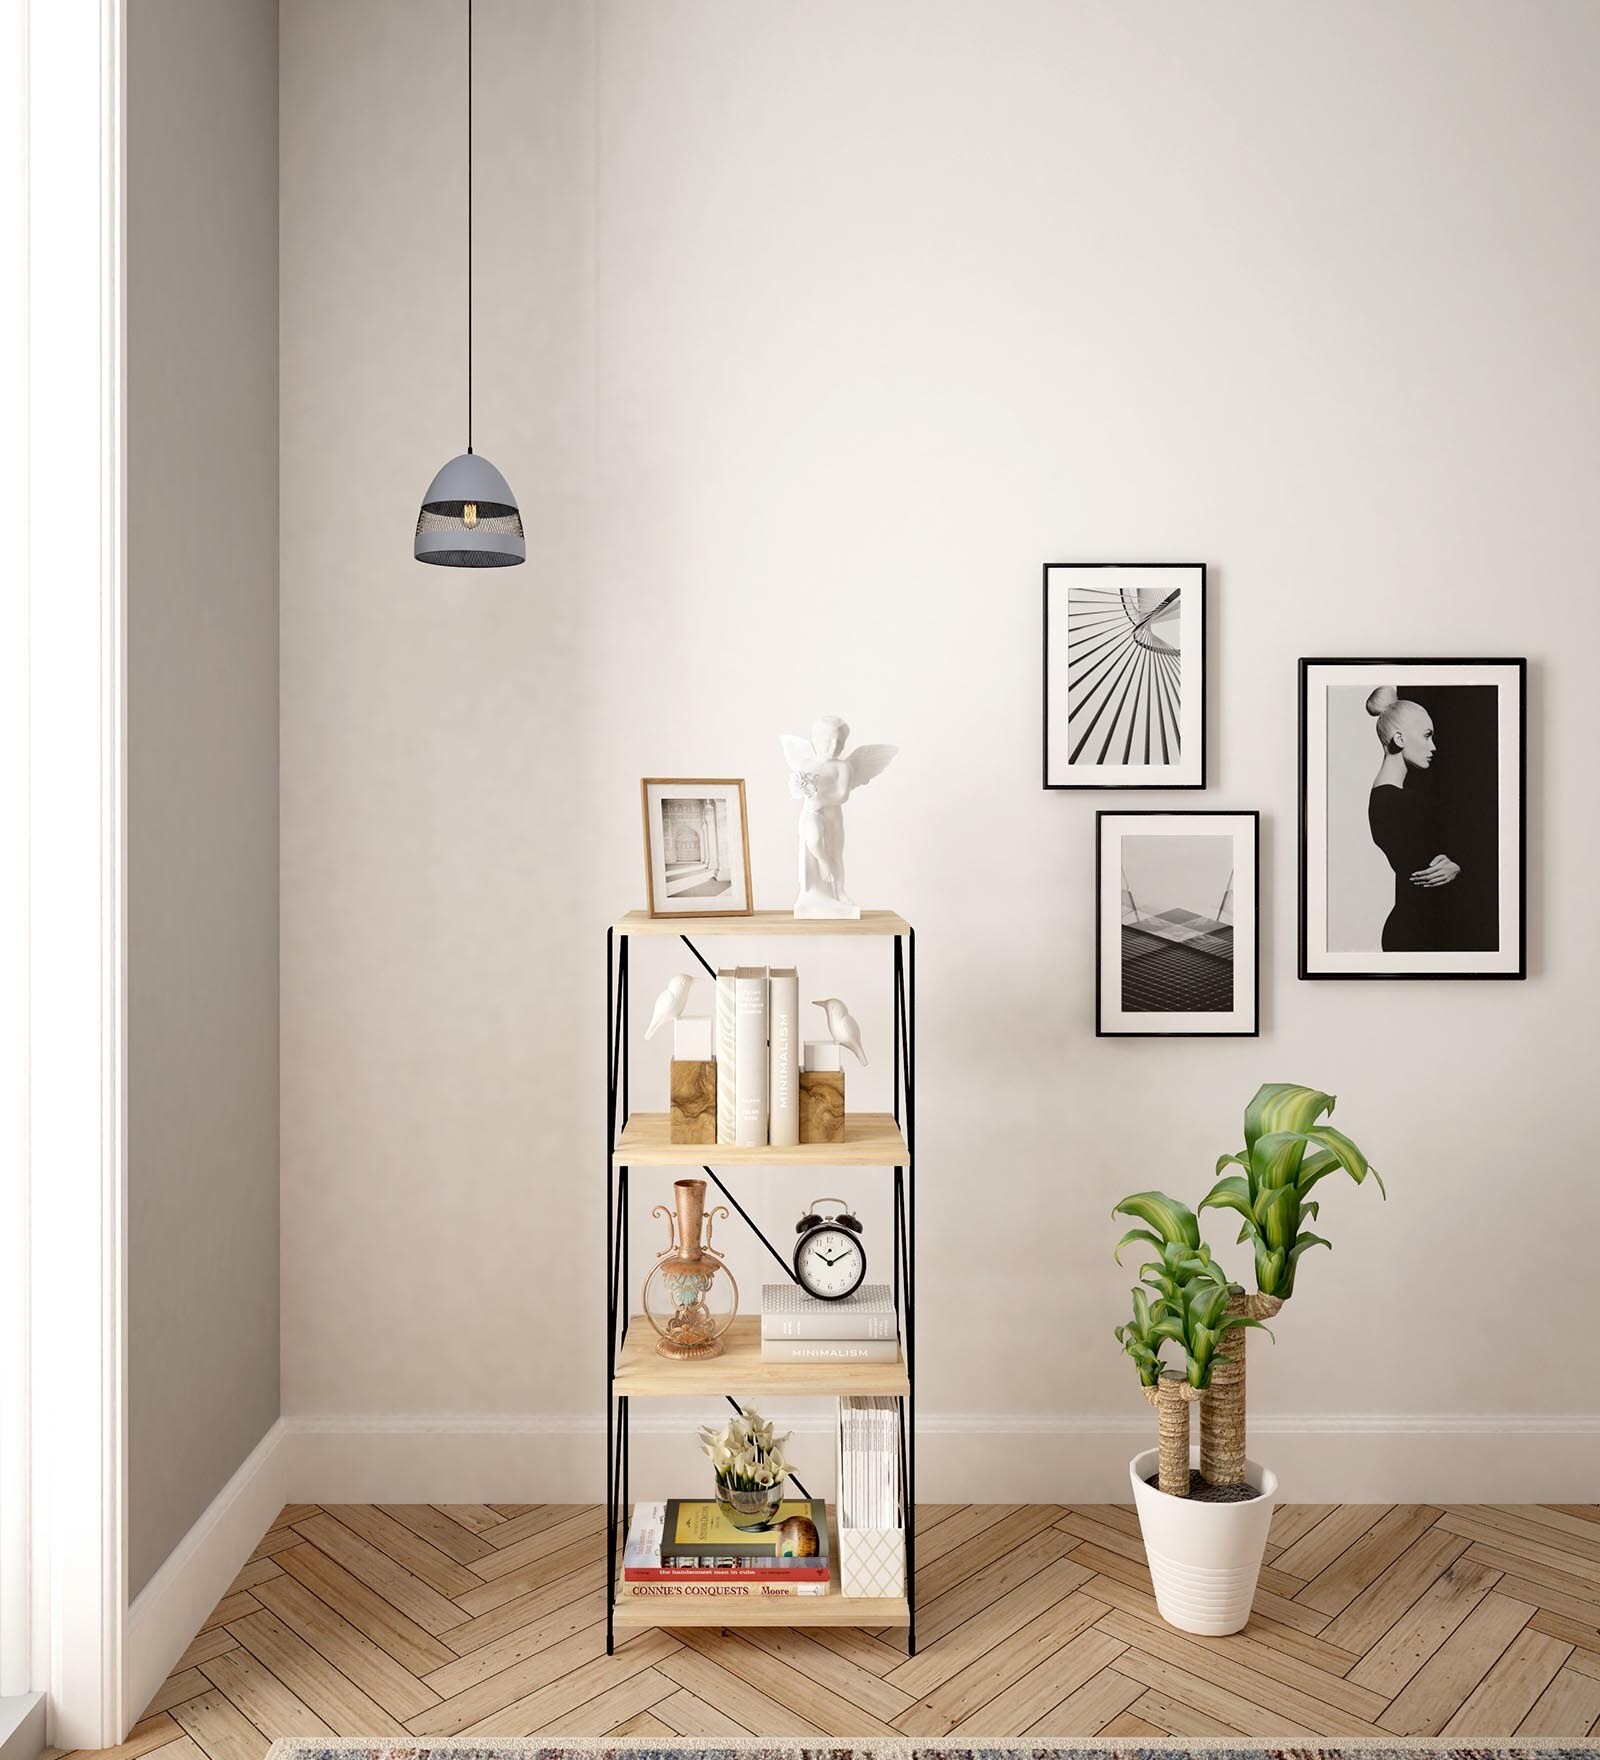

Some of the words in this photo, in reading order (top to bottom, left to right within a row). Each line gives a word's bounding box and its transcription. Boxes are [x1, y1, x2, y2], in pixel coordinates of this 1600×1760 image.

[779, 1014, 789, 1108] MINIMALISM
[792, 1349, 868, 1358] MINIMALISM
[632, 1586, 682, 1595] CONNIE'S
[684, 1586, 749, 1596] CONQUESTS
[761, 1586, 789, 1595] Moore
